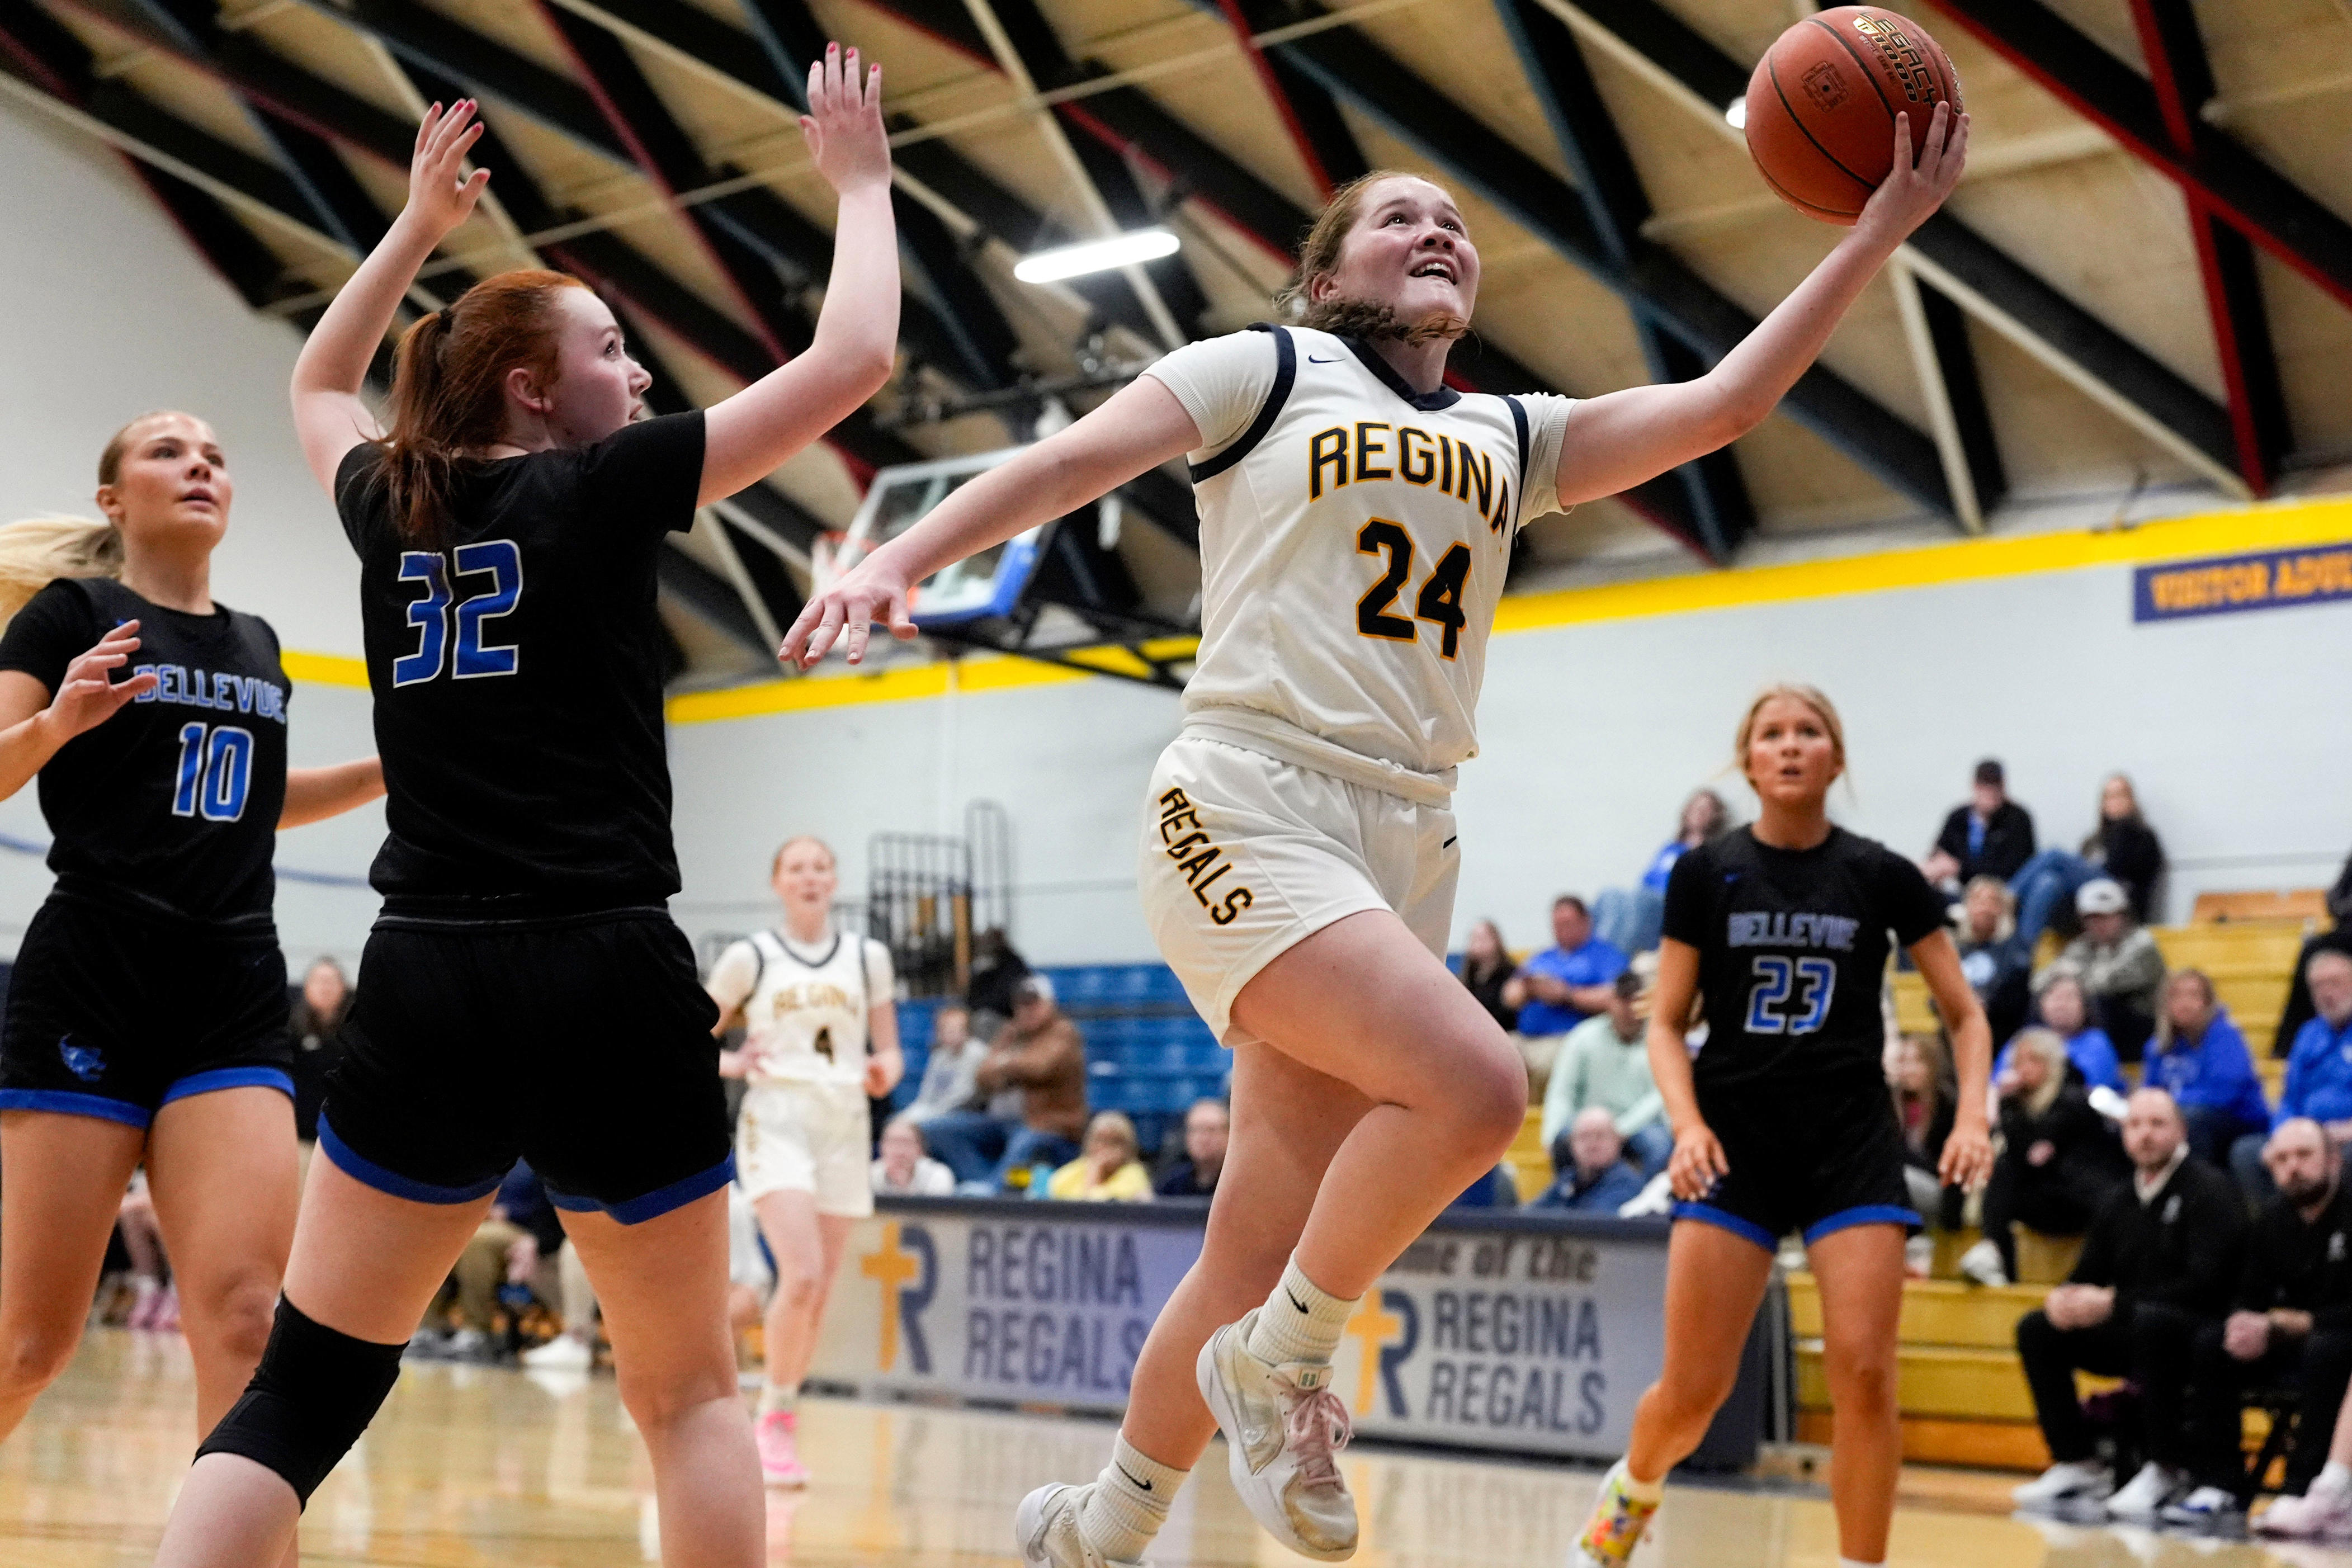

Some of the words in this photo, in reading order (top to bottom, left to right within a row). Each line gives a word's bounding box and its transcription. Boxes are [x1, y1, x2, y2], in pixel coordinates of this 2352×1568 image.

[1871, 34, 1919, 103] 1000
[1308, 421, 1509, 540] REGINA
[393, 539, 524, 689] 32
[1355, 516, 1472, 662] 24
[171, 720, 255, 823] 10
[1158, 787, 1254, 925] REGALS
[1742, 954, 1838, 1036] 23
[813, 1024, 835, 1065] 4
[966, 1224, 1143, 1309] REGINA
[963, 1307, 1149, 1396] REGALS
[1432, 1290, 1602, 1362] REGINA
[1426, 1359, 1607, 1435] REGALS
